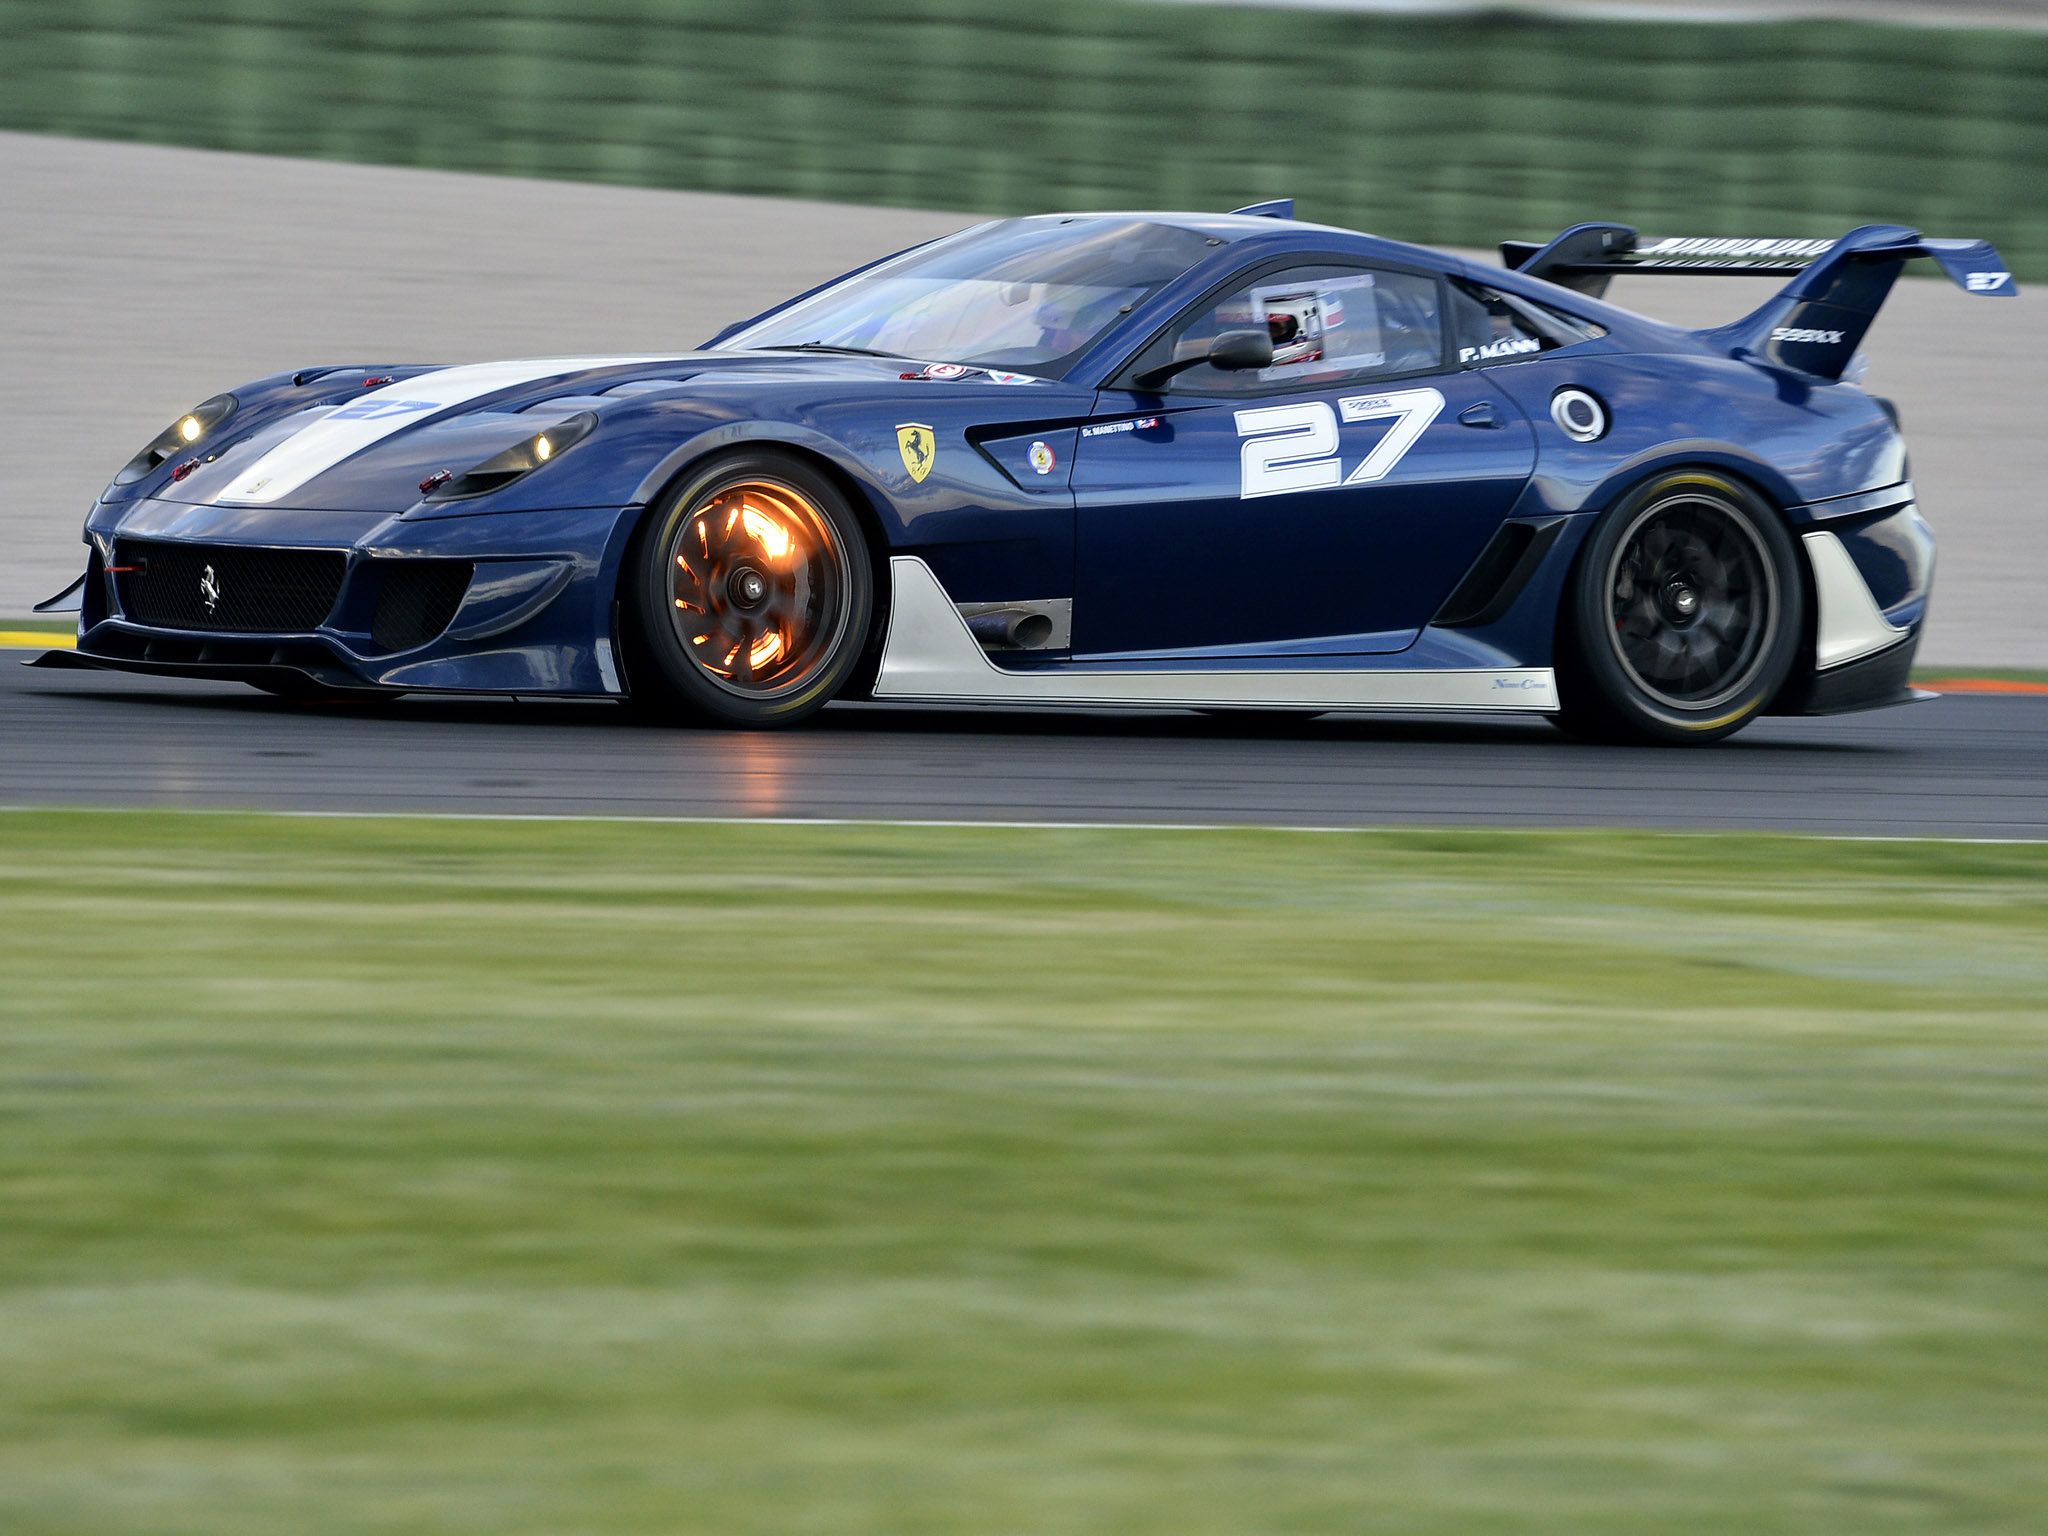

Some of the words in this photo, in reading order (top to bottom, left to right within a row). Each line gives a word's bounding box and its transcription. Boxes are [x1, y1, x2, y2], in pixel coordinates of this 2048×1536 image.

[1966, 272, 2011, 291] 27
[324, 400, 442, 420] 27
[1233, 387, 1446, 500] 27
